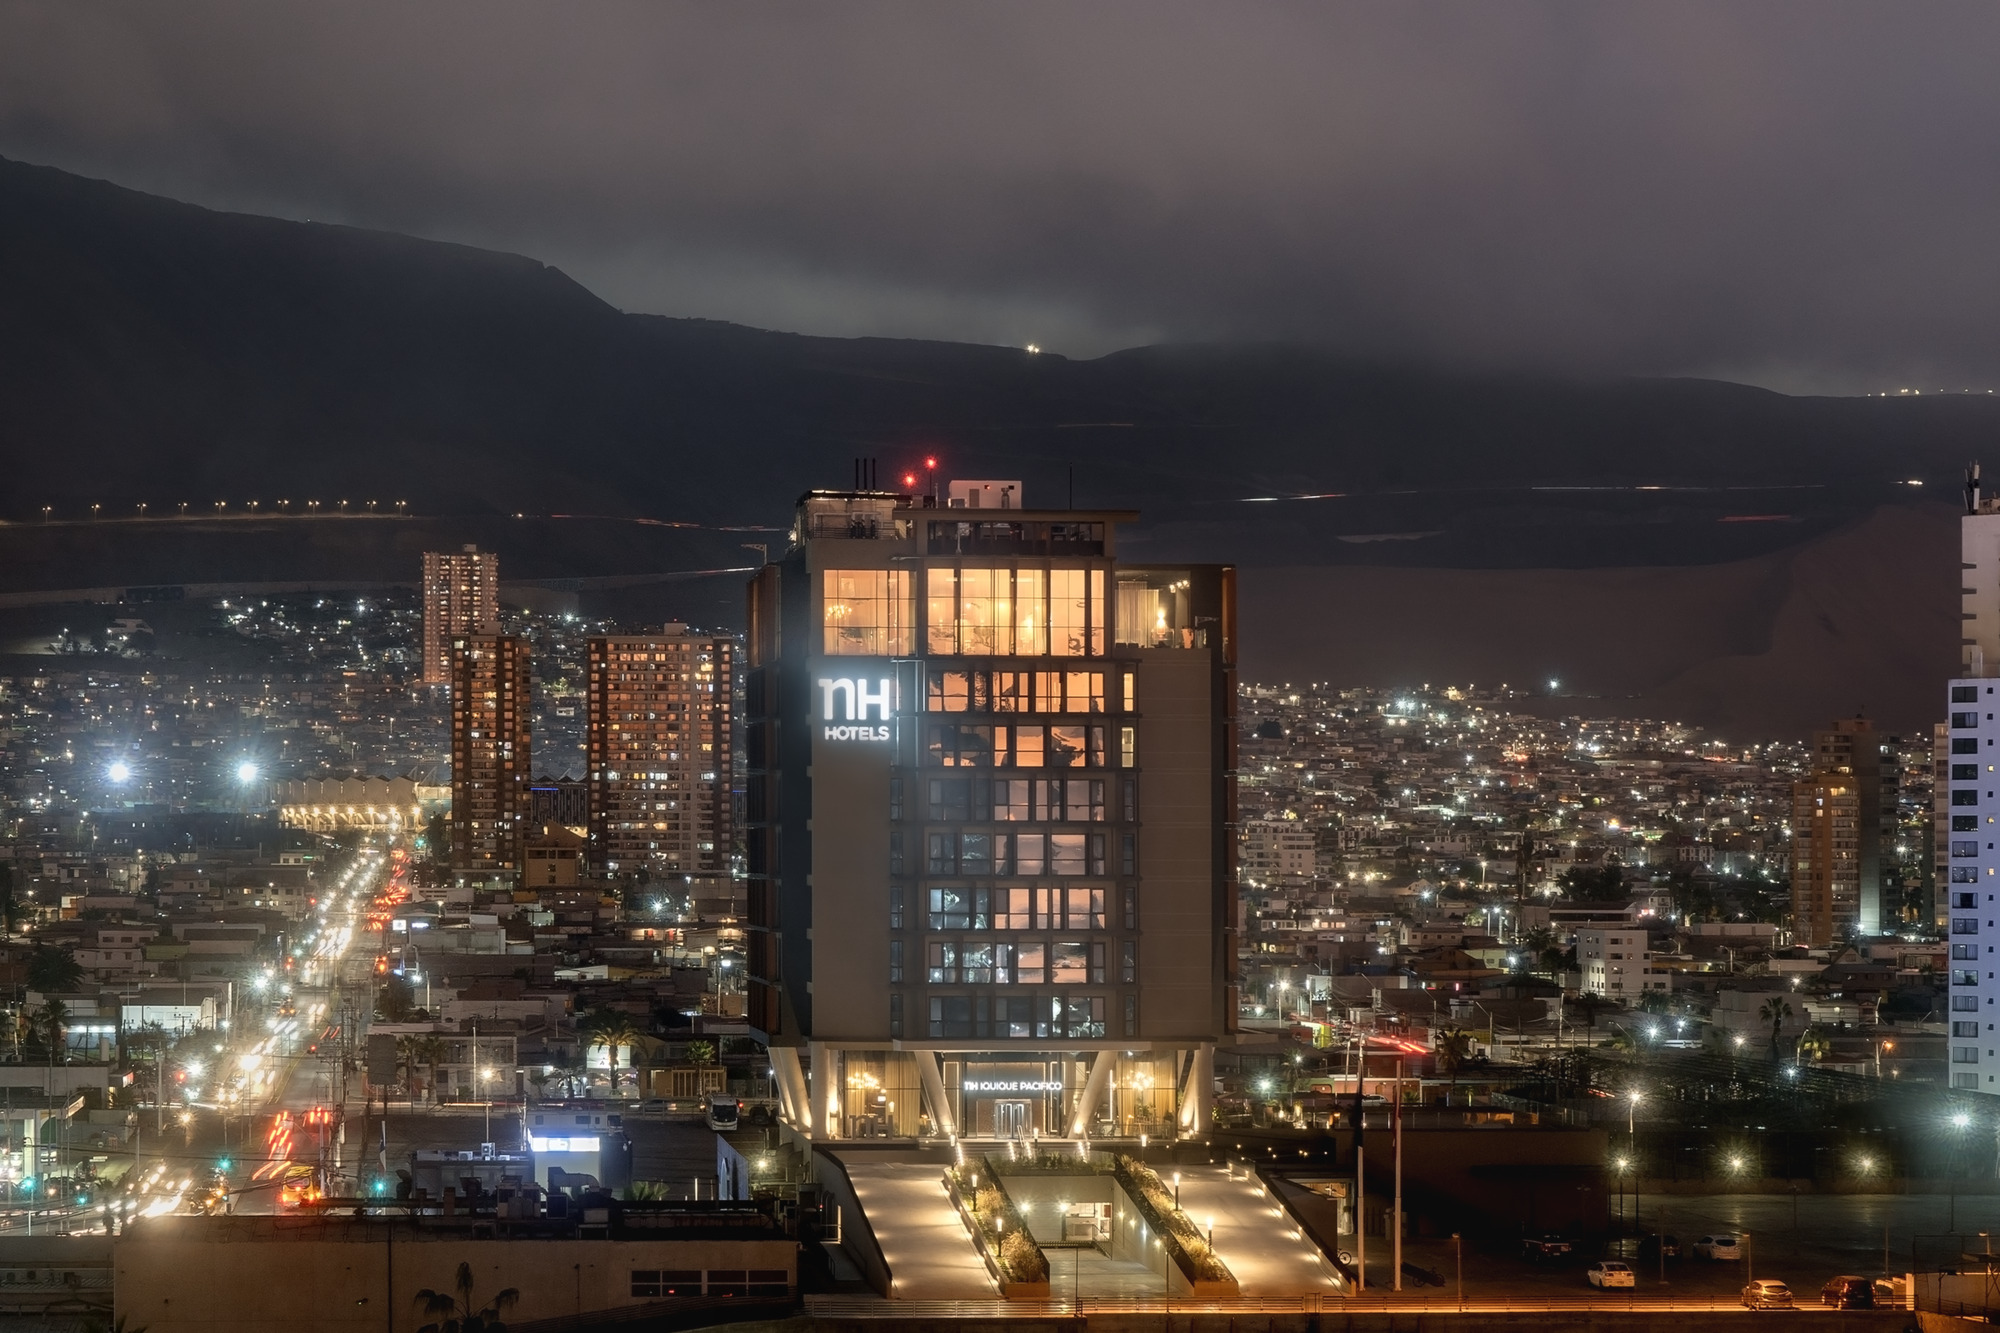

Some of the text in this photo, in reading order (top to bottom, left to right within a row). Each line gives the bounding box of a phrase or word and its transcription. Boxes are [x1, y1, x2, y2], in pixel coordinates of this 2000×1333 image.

[824, 726, 890, 741] HOTELS
[980, 1081, 1018, 1091] IQUIQUE
[1019, 1081, 1063, 1091] PACIFICO
